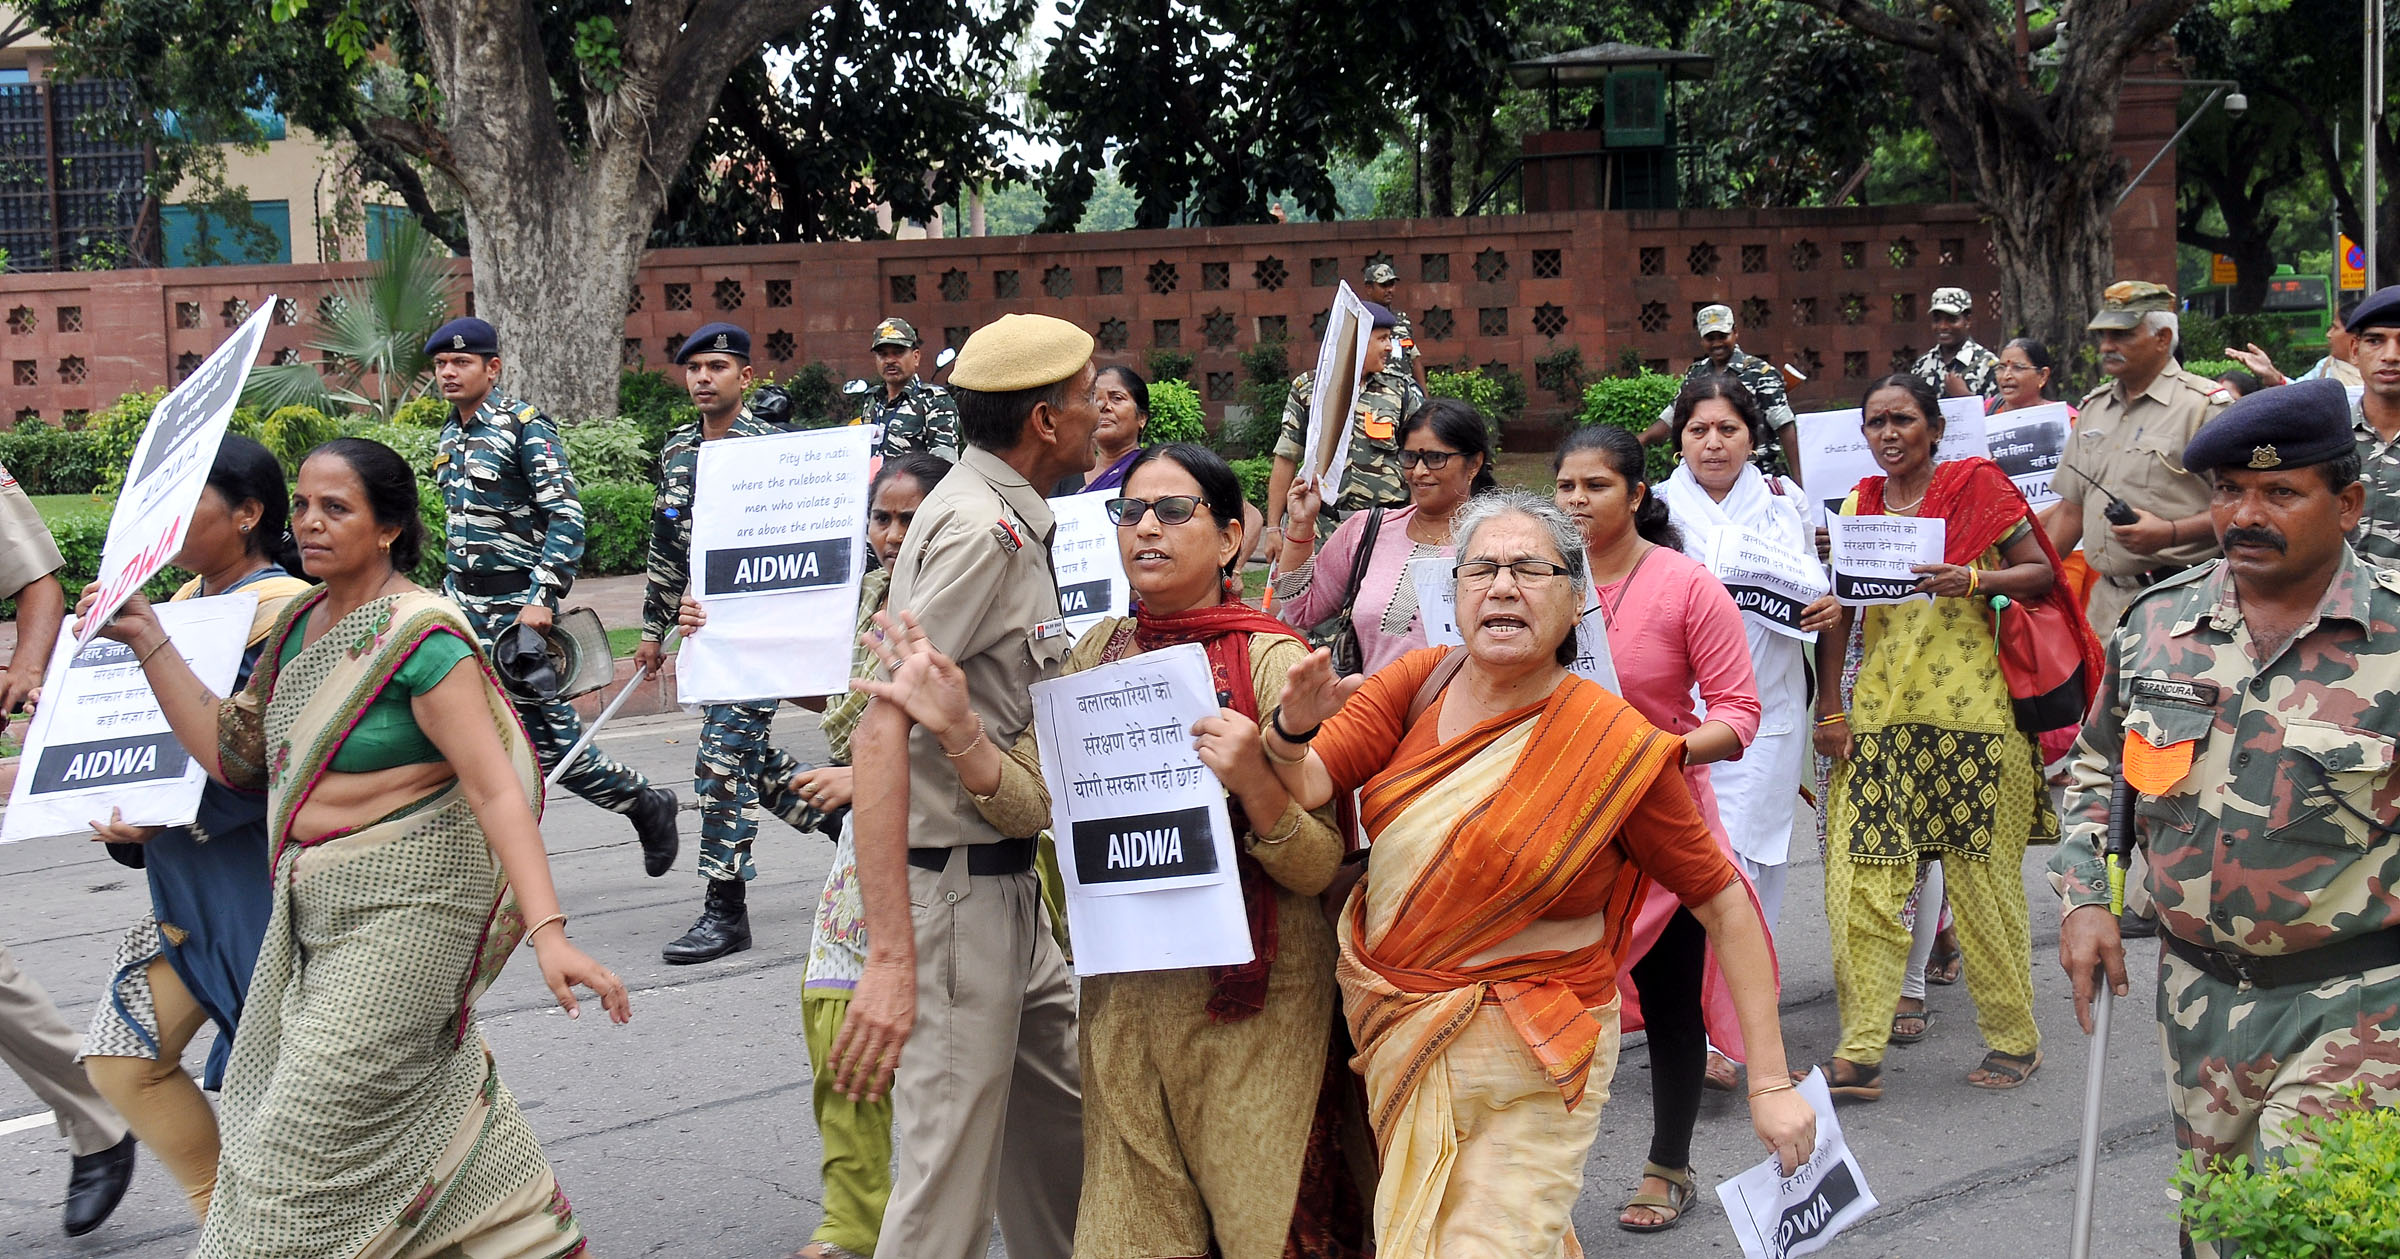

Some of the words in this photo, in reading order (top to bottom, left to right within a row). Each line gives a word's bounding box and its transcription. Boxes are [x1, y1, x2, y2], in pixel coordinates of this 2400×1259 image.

[778, 451, 800, 467] Pity
[804, 449, 822, 462] the
[731, 477, 764, 491] where
[767, 476, 785, 489] the
[788, 471, 832, 487] rulebook
[744, 503, 768, 514] men
[771, 499, 794, 512] who
[797, 496, 831, 509] violate
[737, 527, 754, 538] are
[757, 523, 787, 536] above
[790, 521, 807, 533] the
[810, 515, 854, 530] rulebook
[1841, 521, 1901, 534] बलात्कारियों
[1903, 522, 1918, 535] को
[1843, 540, 1876, 551] संरक्षण
[1878, 538, 1892, 551] देने
[733, 551, 820, 586] AIDWA
[1855, 558, 1887, 570] सरकार
[81, 515, 181, 641] AIDWA
[1850, 581, 1917, 596] AIDWA
[1734, 591, 1791, 622] AIDWA
[1076, 676, 1150, 714] बलात्कारियों
[1151, 674, 1174, 701] को
[1082, 732, 1125, 758] संरक्षण
[1126, 722, 1147, 752] देने
[1149, 716, 1185, 745] वाली
[62, 744, 158, 783] AIDWA
[1073, 772, 1104, 800] योगी
[1105, 772, 1149, 797] सरकार
[1149, 763, 1174, 794] गद्दी
[1107, 826, 1184, 870] AIDWA
